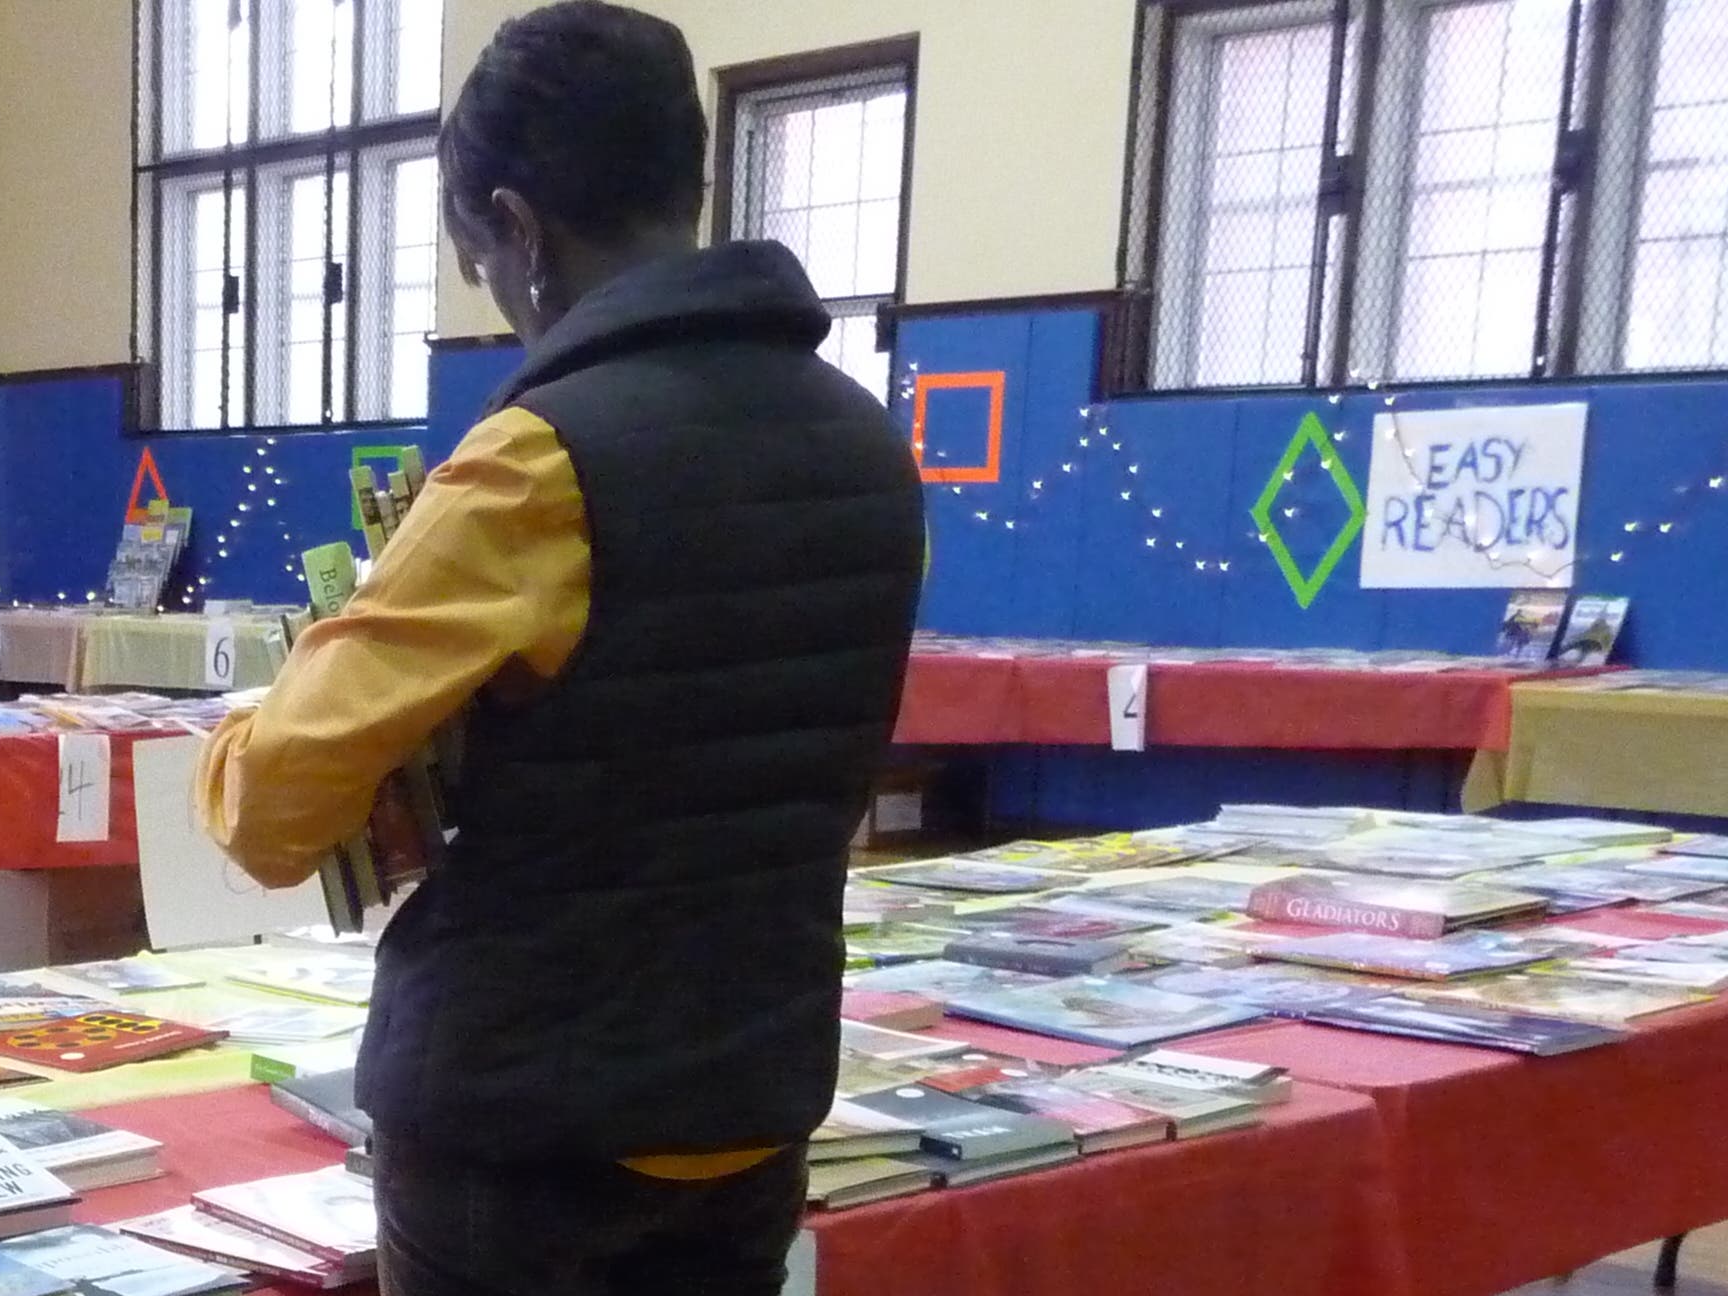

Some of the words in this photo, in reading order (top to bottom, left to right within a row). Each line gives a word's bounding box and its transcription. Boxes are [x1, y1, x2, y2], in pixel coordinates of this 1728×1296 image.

[1427, 437, 1528, 490] EASY
[1382, 486, 1570, 553] READERS
[319, 566, 346, 615] Belo
[213, 636, 231, 679] 6
[68, 759, 93, 821] 4
[1286, 897, 1402, 931] GLADIATORS
